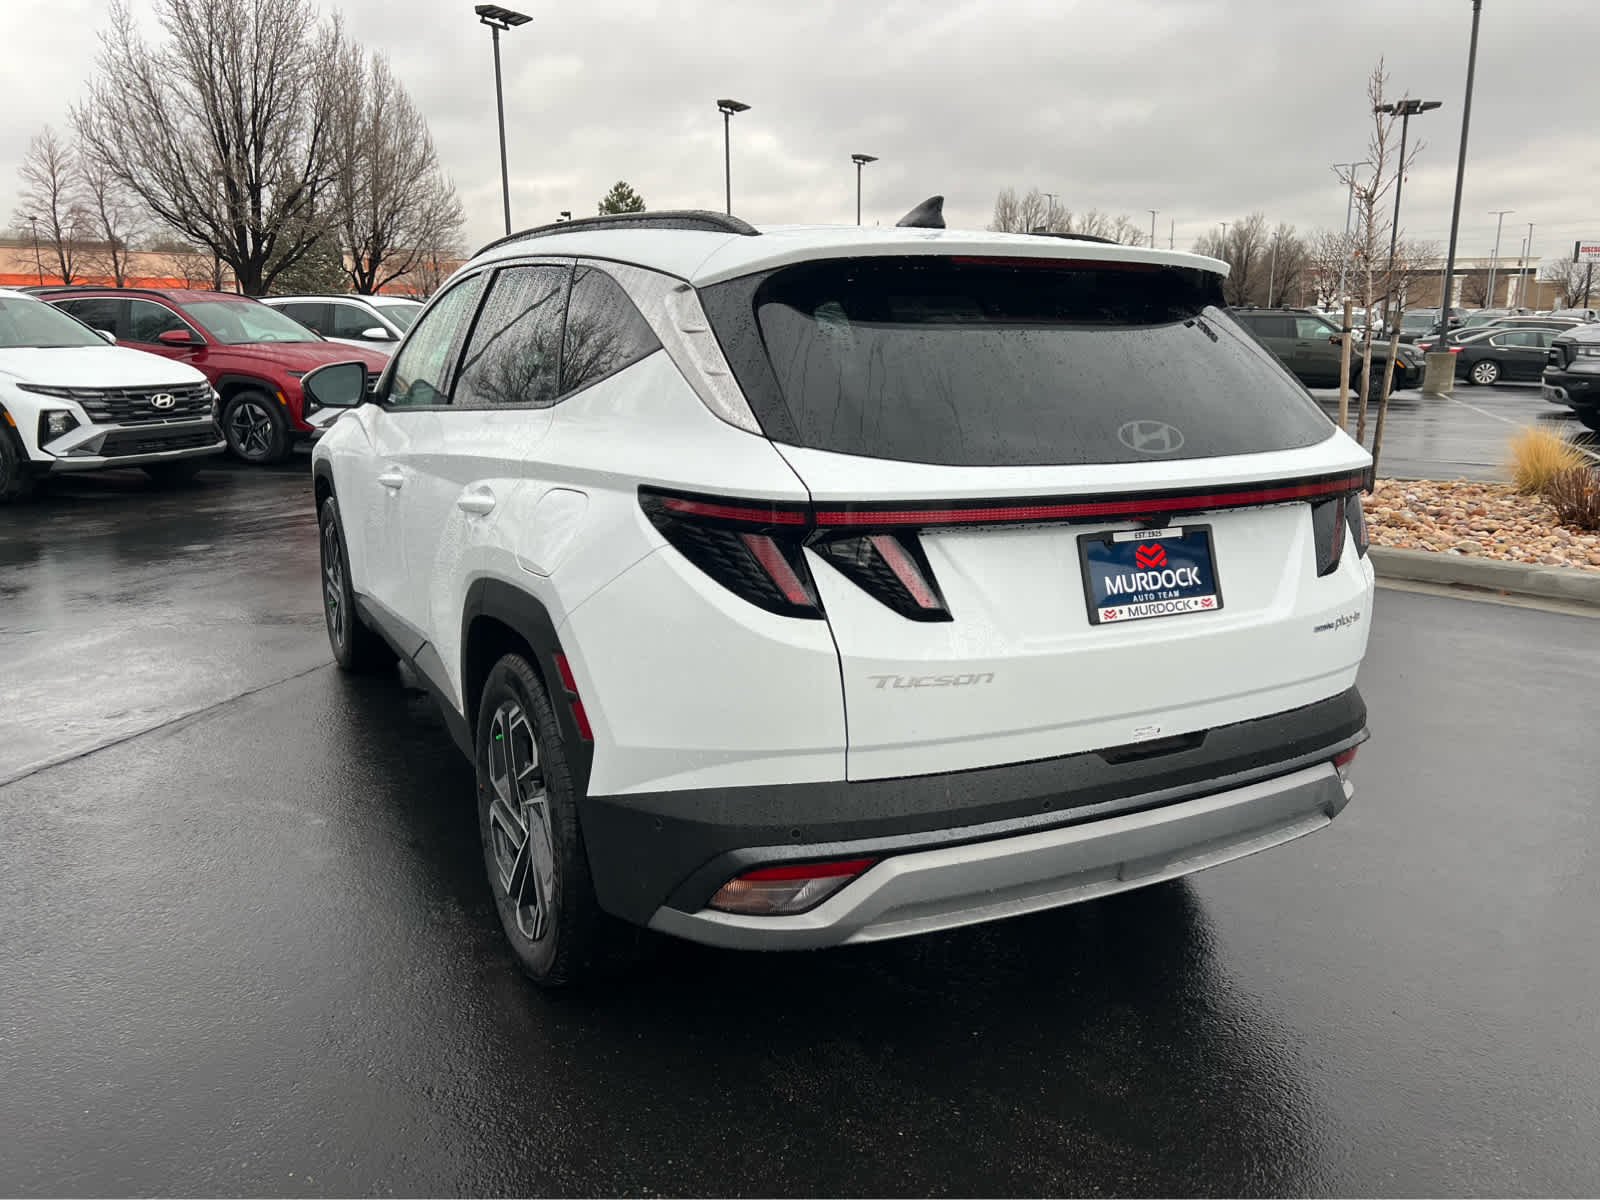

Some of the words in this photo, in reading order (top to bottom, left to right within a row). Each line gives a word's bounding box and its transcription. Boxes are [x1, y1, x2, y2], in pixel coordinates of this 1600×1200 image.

[1104, 567, 1202, 595] MURDOCK
[1133, 592, 1155, 603] AUTO
[1158, 590, 1180, 600] TEAM
[1128, 600, 1193, 617] MURDOCK
